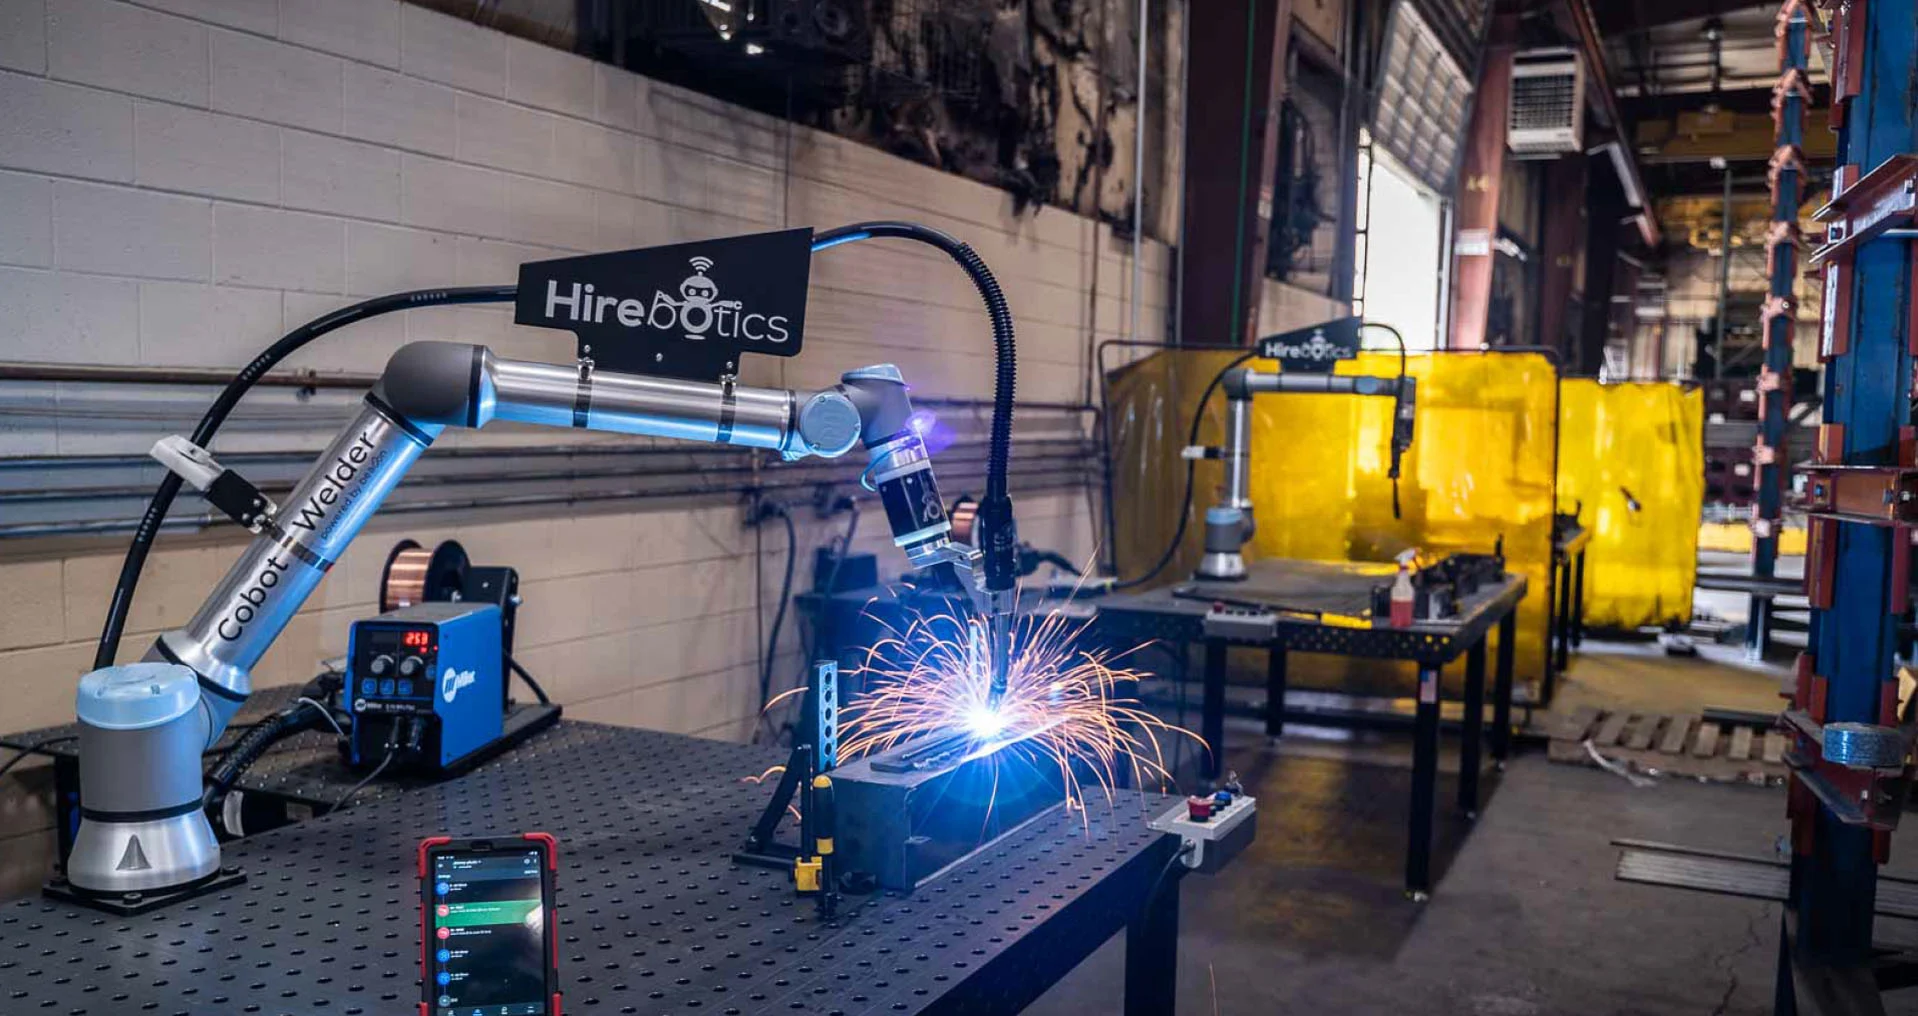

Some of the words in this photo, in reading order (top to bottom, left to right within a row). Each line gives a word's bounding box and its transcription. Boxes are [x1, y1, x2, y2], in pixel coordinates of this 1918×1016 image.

[545, 279, 789, 343] Hirebotics
[218, 556, 288, 642] Cobot
[292, 432, 375, 532] Welder
[320, 497, 352, 540] powered
[350, 486, 362, 499] by
